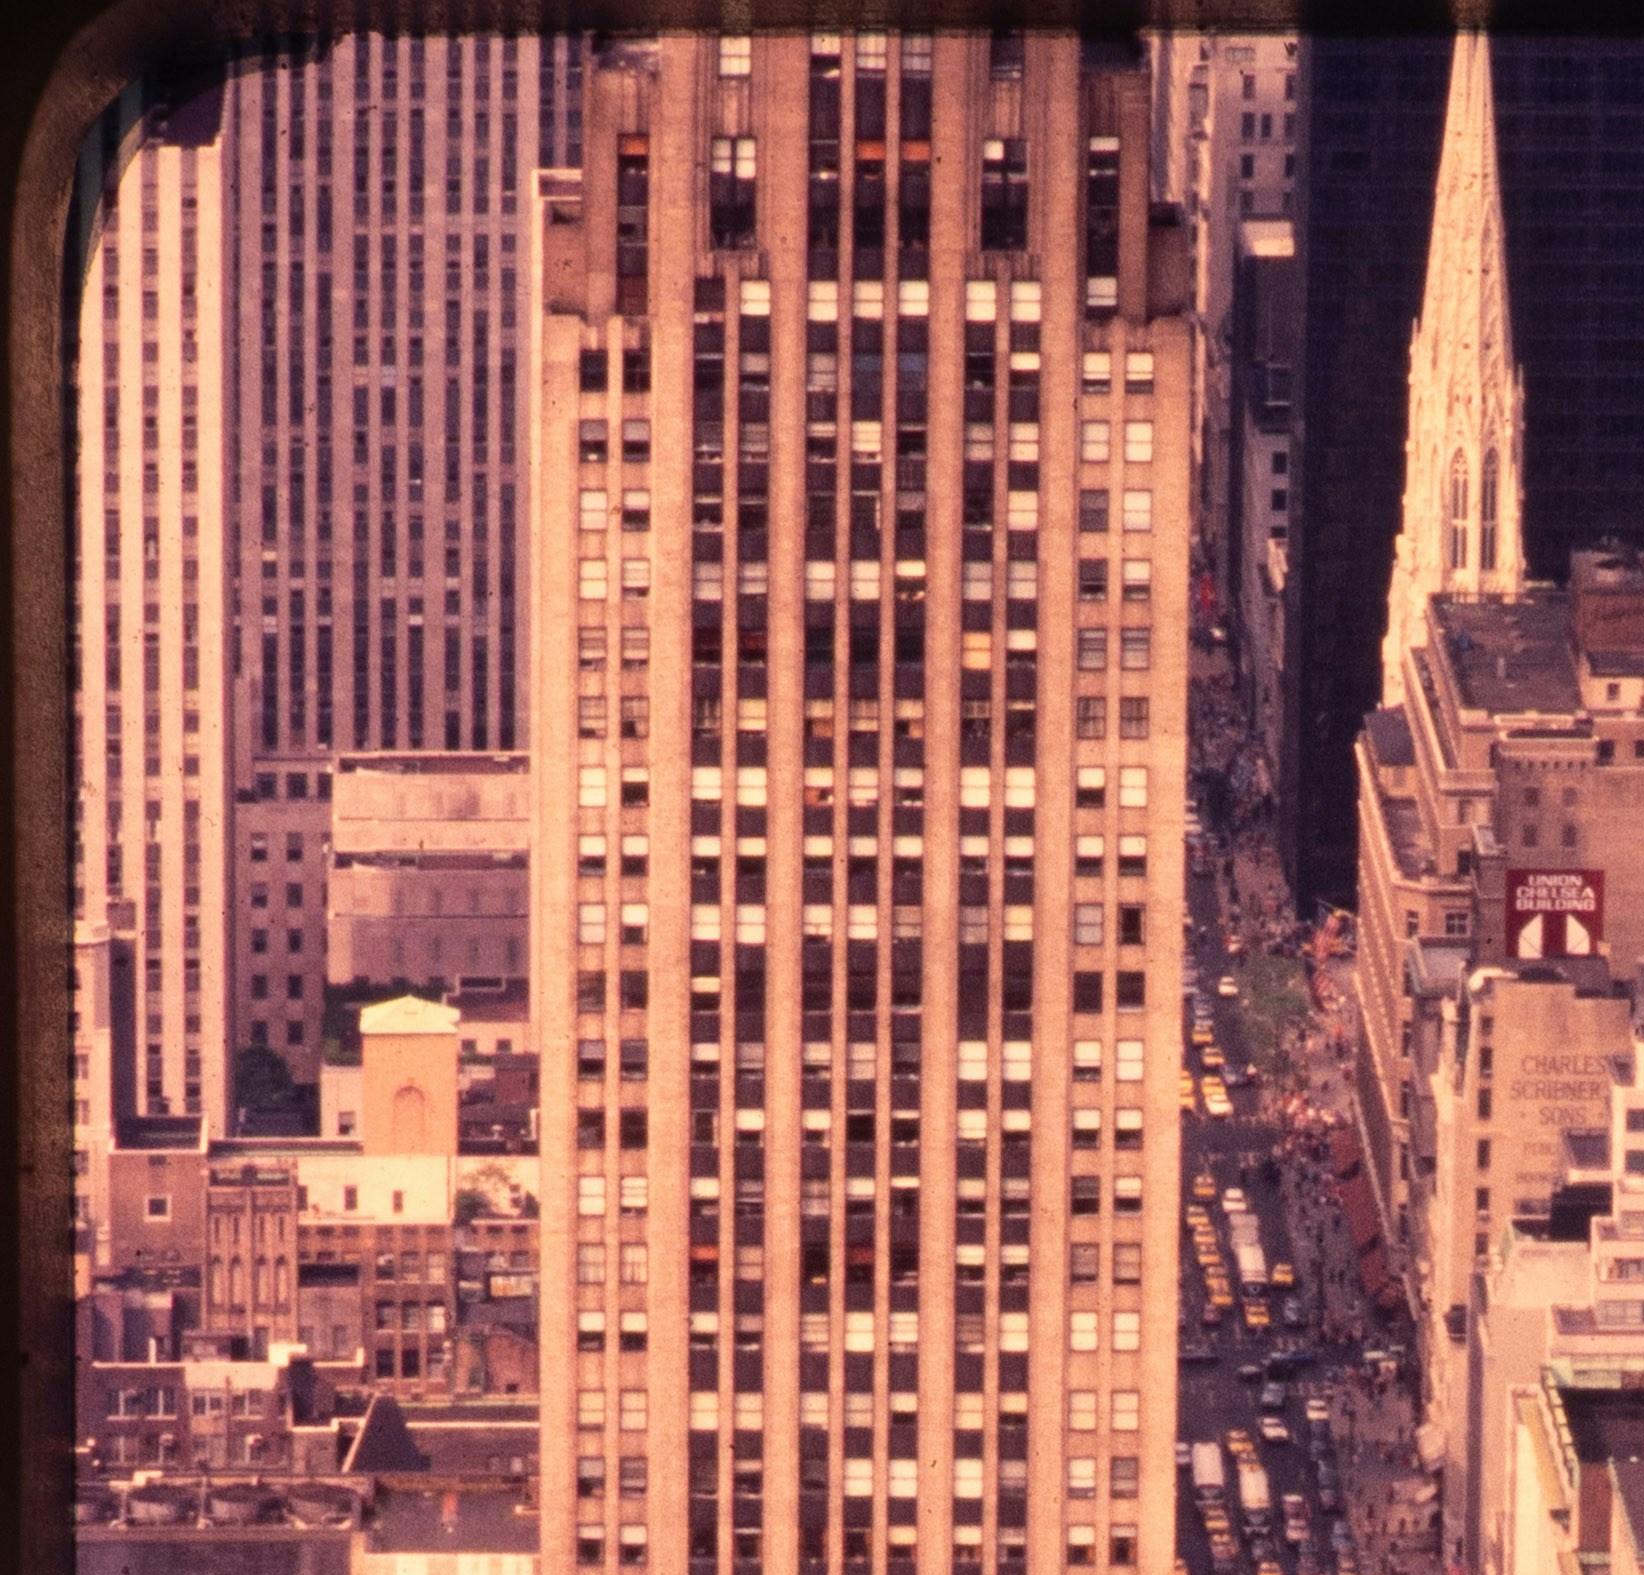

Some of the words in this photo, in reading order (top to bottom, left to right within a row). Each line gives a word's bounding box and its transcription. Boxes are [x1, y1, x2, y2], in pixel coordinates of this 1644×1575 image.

[1528, 875, 1582, 886] UNION
[1517, 887, 1594, 899] CHELSEA
[1516, 899, 1594, 911] BUILDING
[1521, 1055, 1606, 1075] CHARLES
[1539, 1106, 1587, 1125] SONS
